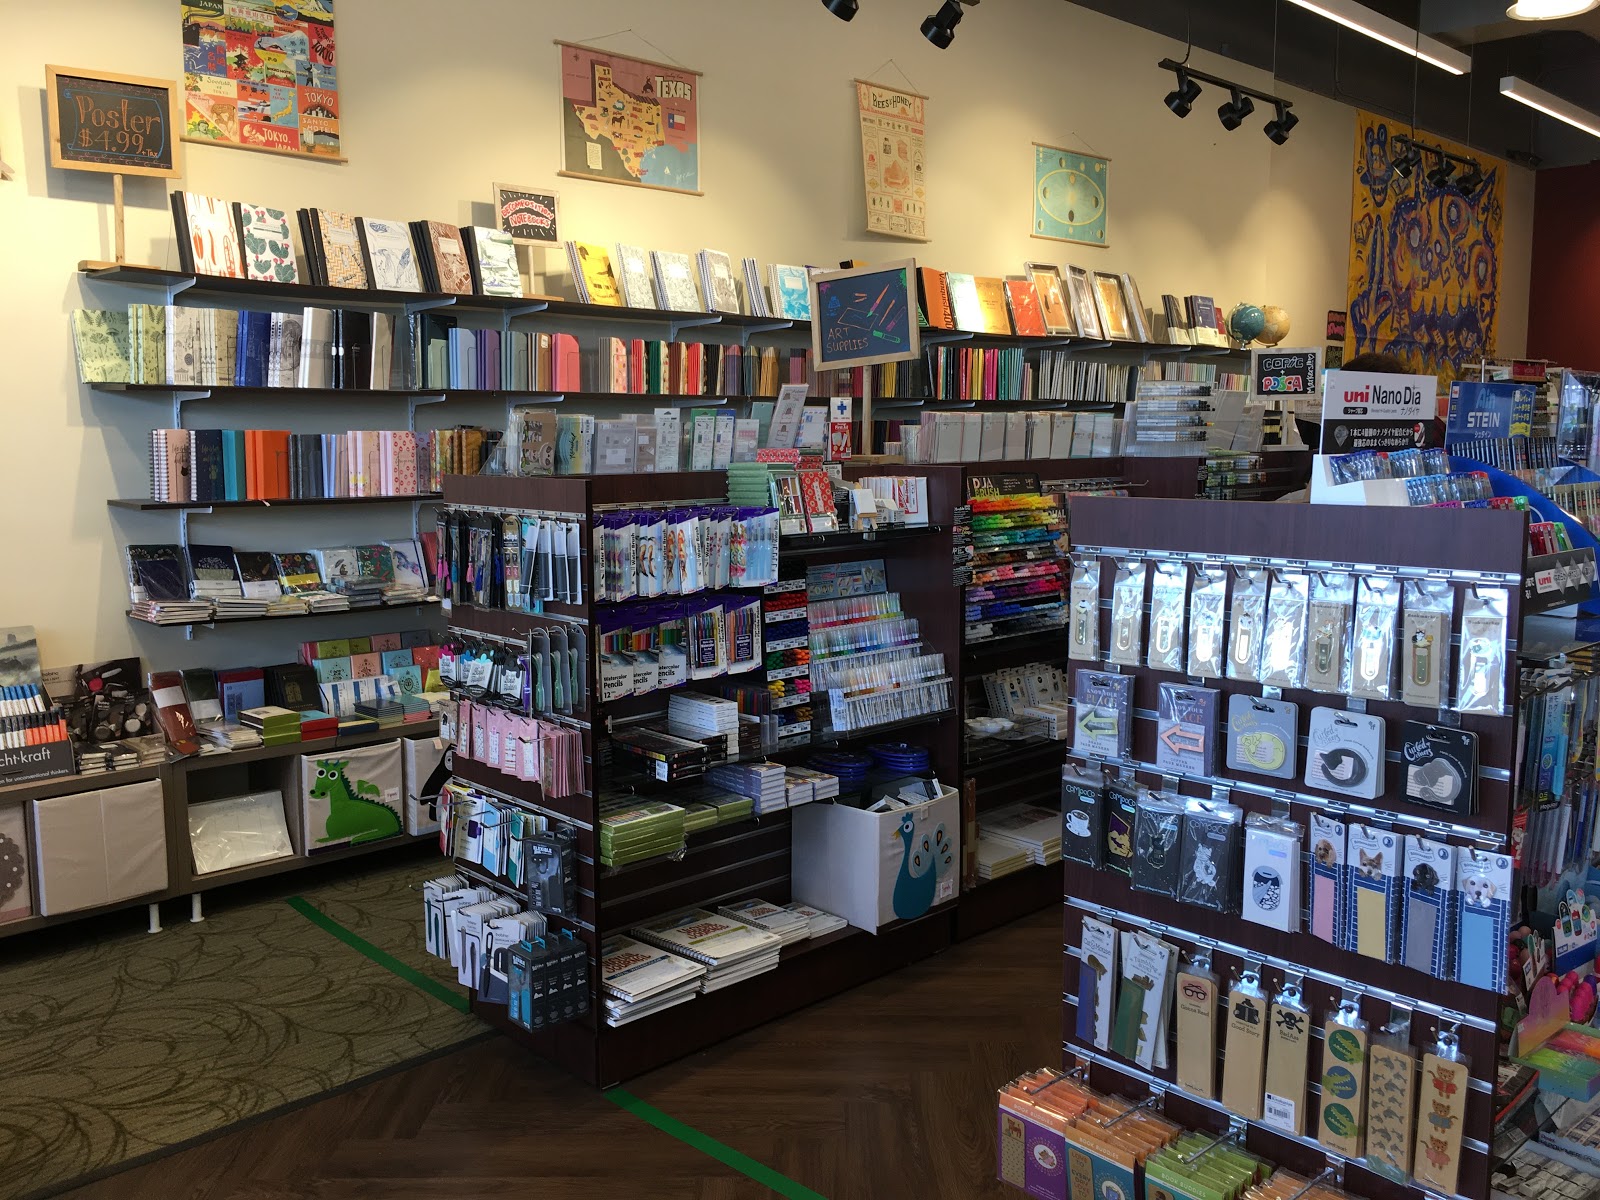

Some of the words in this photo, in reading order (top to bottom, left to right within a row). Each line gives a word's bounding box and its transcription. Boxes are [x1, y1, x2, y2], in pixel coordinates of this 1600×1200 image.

[655, 76, 692, 101] TEXAS
[305, 93, 334, 107] TOKYO
[872, 92, 889, 109] BEES
[892, 95, 912, 109] HONEY
[76, 95, 161, 135] Poster
[302, 118, 328, 126] SANYO
[308, 126, 336, 134] HOTEL
[78, 128, 145, 154] $4.99
[501, 199, 554, 220] DECOMPOSITION
[509, 212, 551, 228] NOTEBOOKS
[828, 327, 849, 340] ART
[826, 338, 869, 353] SUPPLIES
[1262, 356, 1304, 371] COPIC
[1262, 376, 1303, 392] POSCA
[1344, 384, 1370, 403] uni
[1372, 385, 1402, 405] Nano
[1404, 386, 1421, 405] Dia
[1476, 387, 1496, 409] Ain
[1467, 412, 1500, 428] STEIN
[603, 674, 627, 682] Watercolor
[603, 680, 623, 688] Pencils
[604, 691, 611, 699] 12
[1086, 688, 1102, 696] KNOW
[1103, 690, 1117, 698] YOUR
[1086, 694, 1118, 706] PLACE
[14, 771, 49, 782] unconventional
[1231, 1023, 1245, 1034] Good
[1013, 1103, 1028, 1114] BOOK
[1030, 1111, 1053, 1126] BUDDIES
[1079, 1137, 1095, 1148] BOOK
[1096, 1145, 1119, 1160] BUDDIES
[1161, 1173, 1178, 1184] BOOK
[1180, 1180, 1207, 1198] BUDDIES
